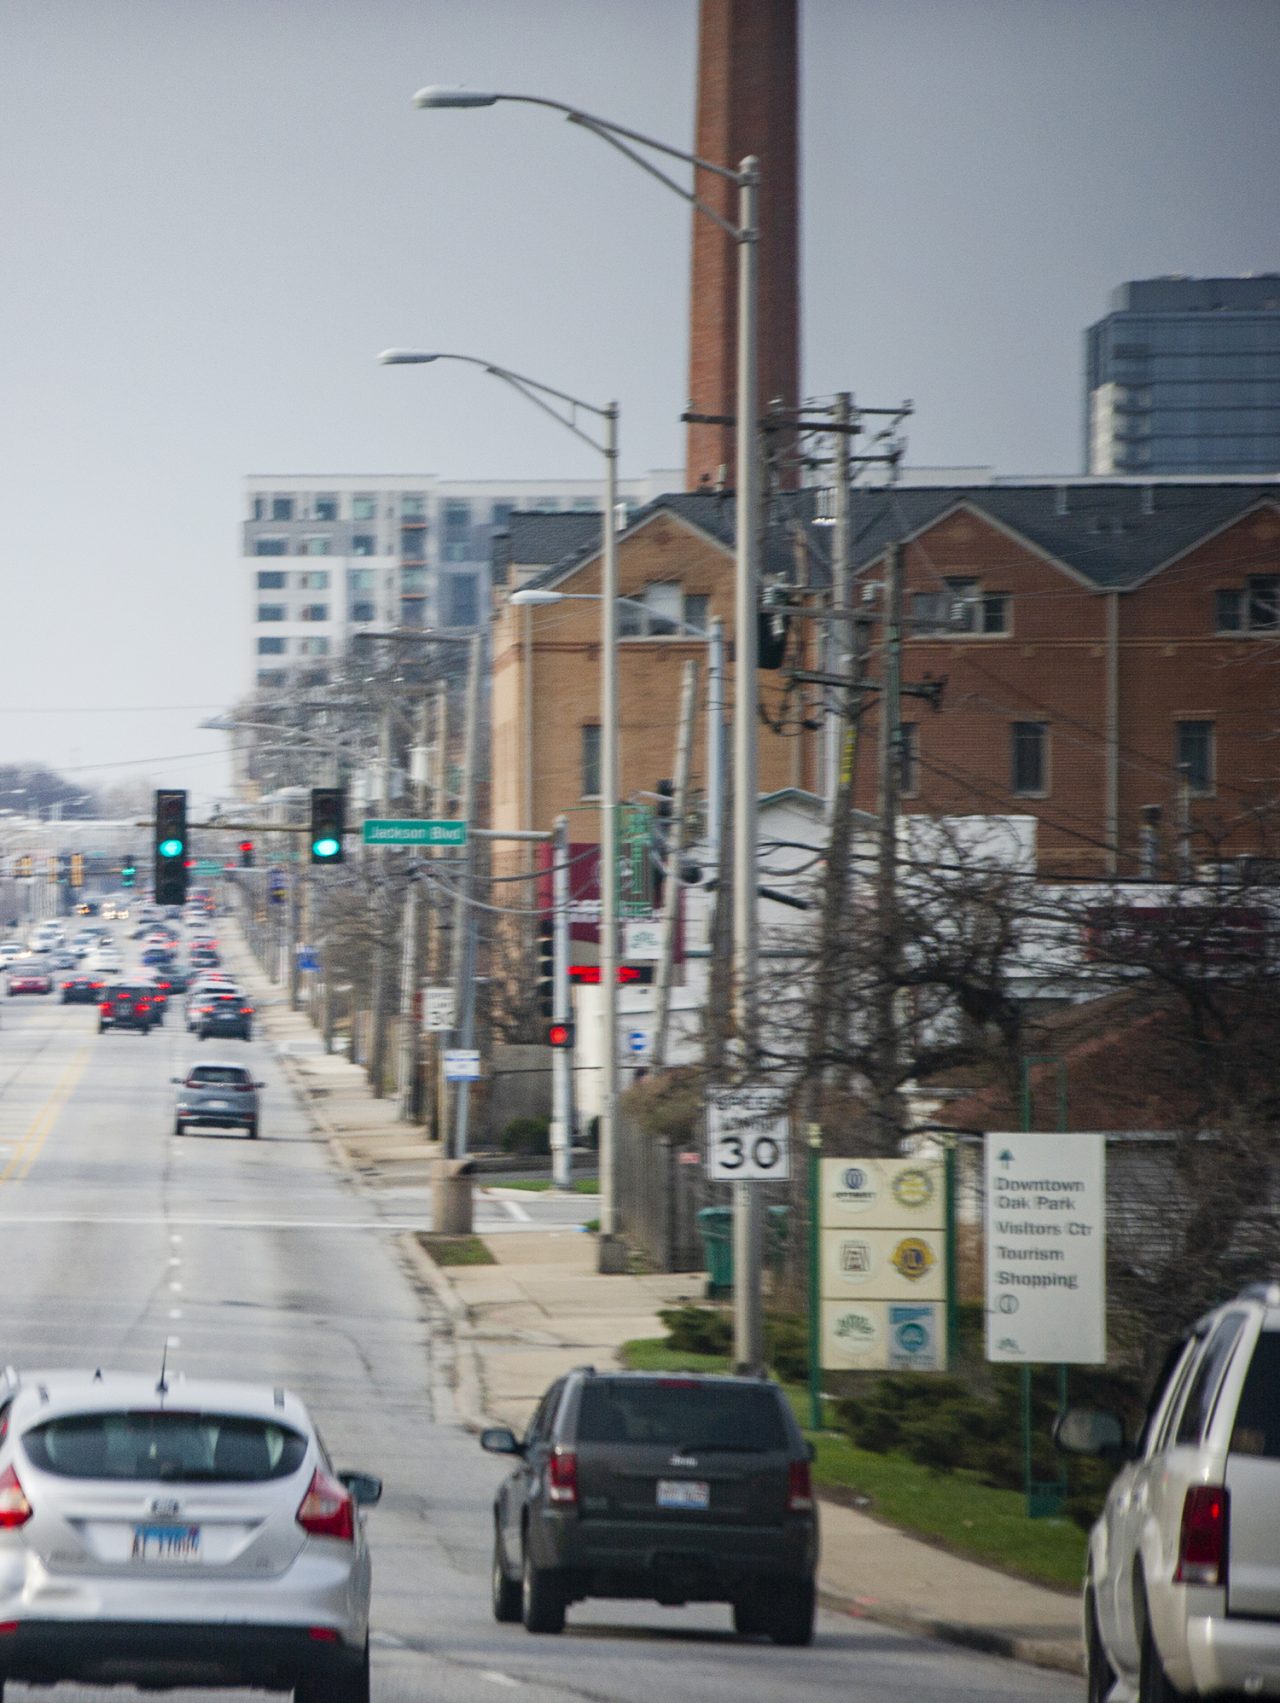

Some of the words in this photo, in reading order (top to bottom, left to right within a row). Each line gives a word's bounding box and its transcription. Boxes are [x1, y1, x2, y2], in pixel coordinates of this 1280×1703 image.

[369, 826, 426, 840] Jackson
[429, 826, 463, 840] Blvd
[720, 1137, 780, 1170] 30
[996, 1177, 1085, 1193] Downtown
[997, 1196, 1030, 1211] Oak
[1037, 1196, 1076, 1211] Park
[996, 1221, 1062, 1236] Visitors
[1067, 1222, 1094, 1237] Ctr
[997, 1246, 1065, 1262] Tourism
[996, 1271, 1079, 1290] Shopping
